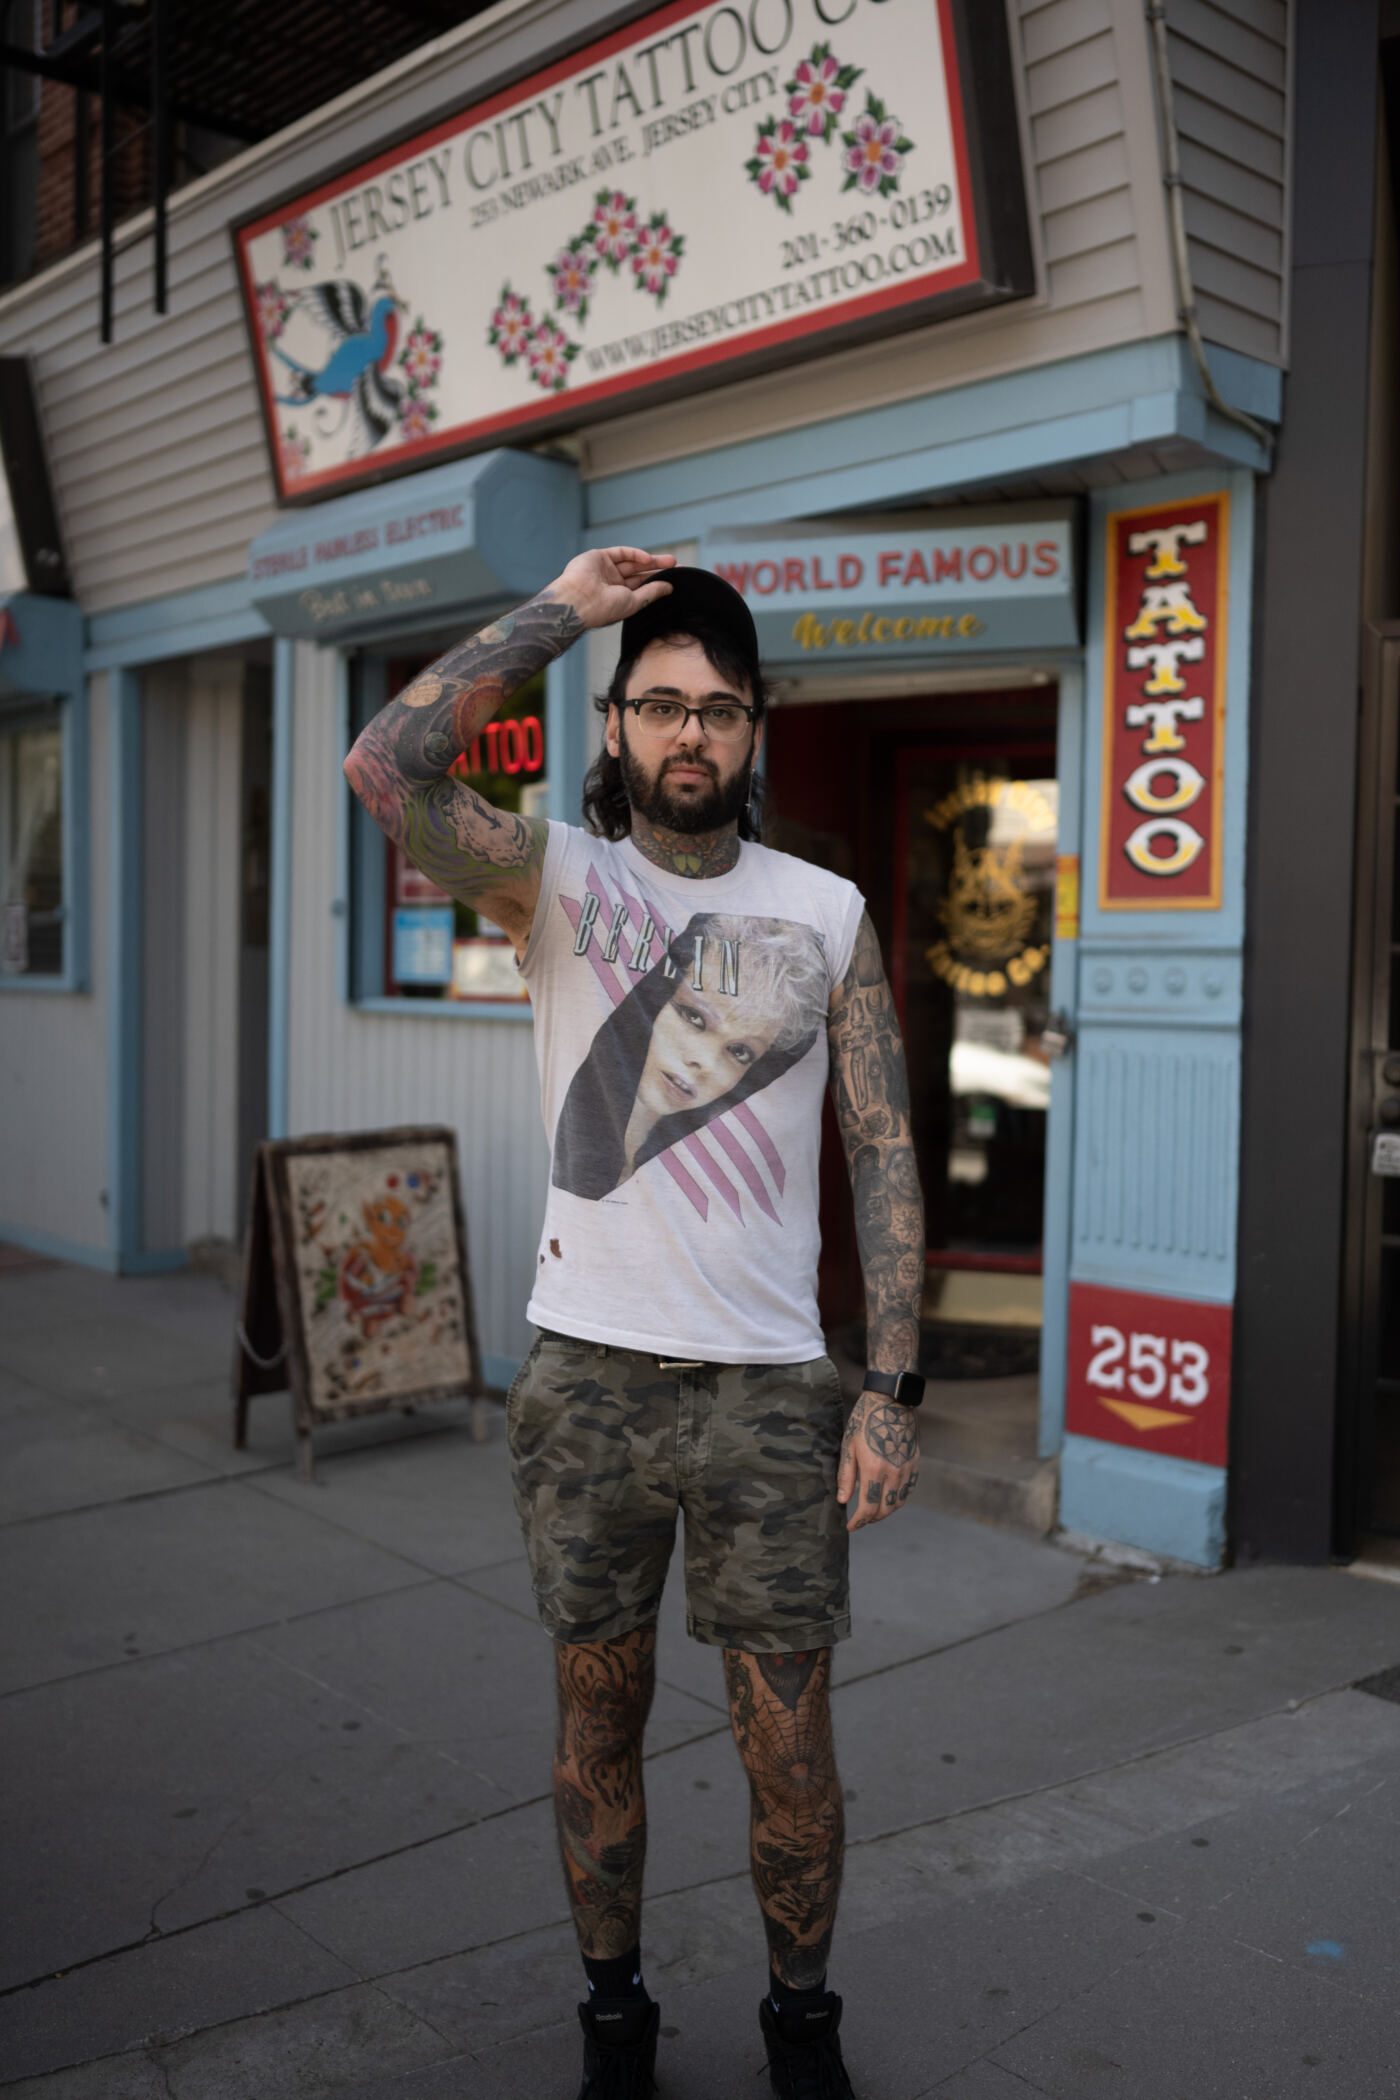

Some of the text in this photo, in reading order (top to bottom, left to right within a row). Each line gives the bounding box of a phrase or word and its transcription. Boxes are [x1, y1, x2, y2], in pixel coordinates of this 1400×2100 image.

[329, 0, 793, 271] JERSEY CITY TATTOO
[499, 154, 588, 211] NEWARK
[640, 94, 718, 158] JERSEY
[720, 65, 779, 114] CITY
[714, 541, 1059, 597] WORLD FAMOUS
[792, 612, 985, 651] Welcome
[1124, 520, 1206, 876] TATTOO
[572, 892, 742, 997] BERLIN
[1086, 1324, 1209, 1406] 253
